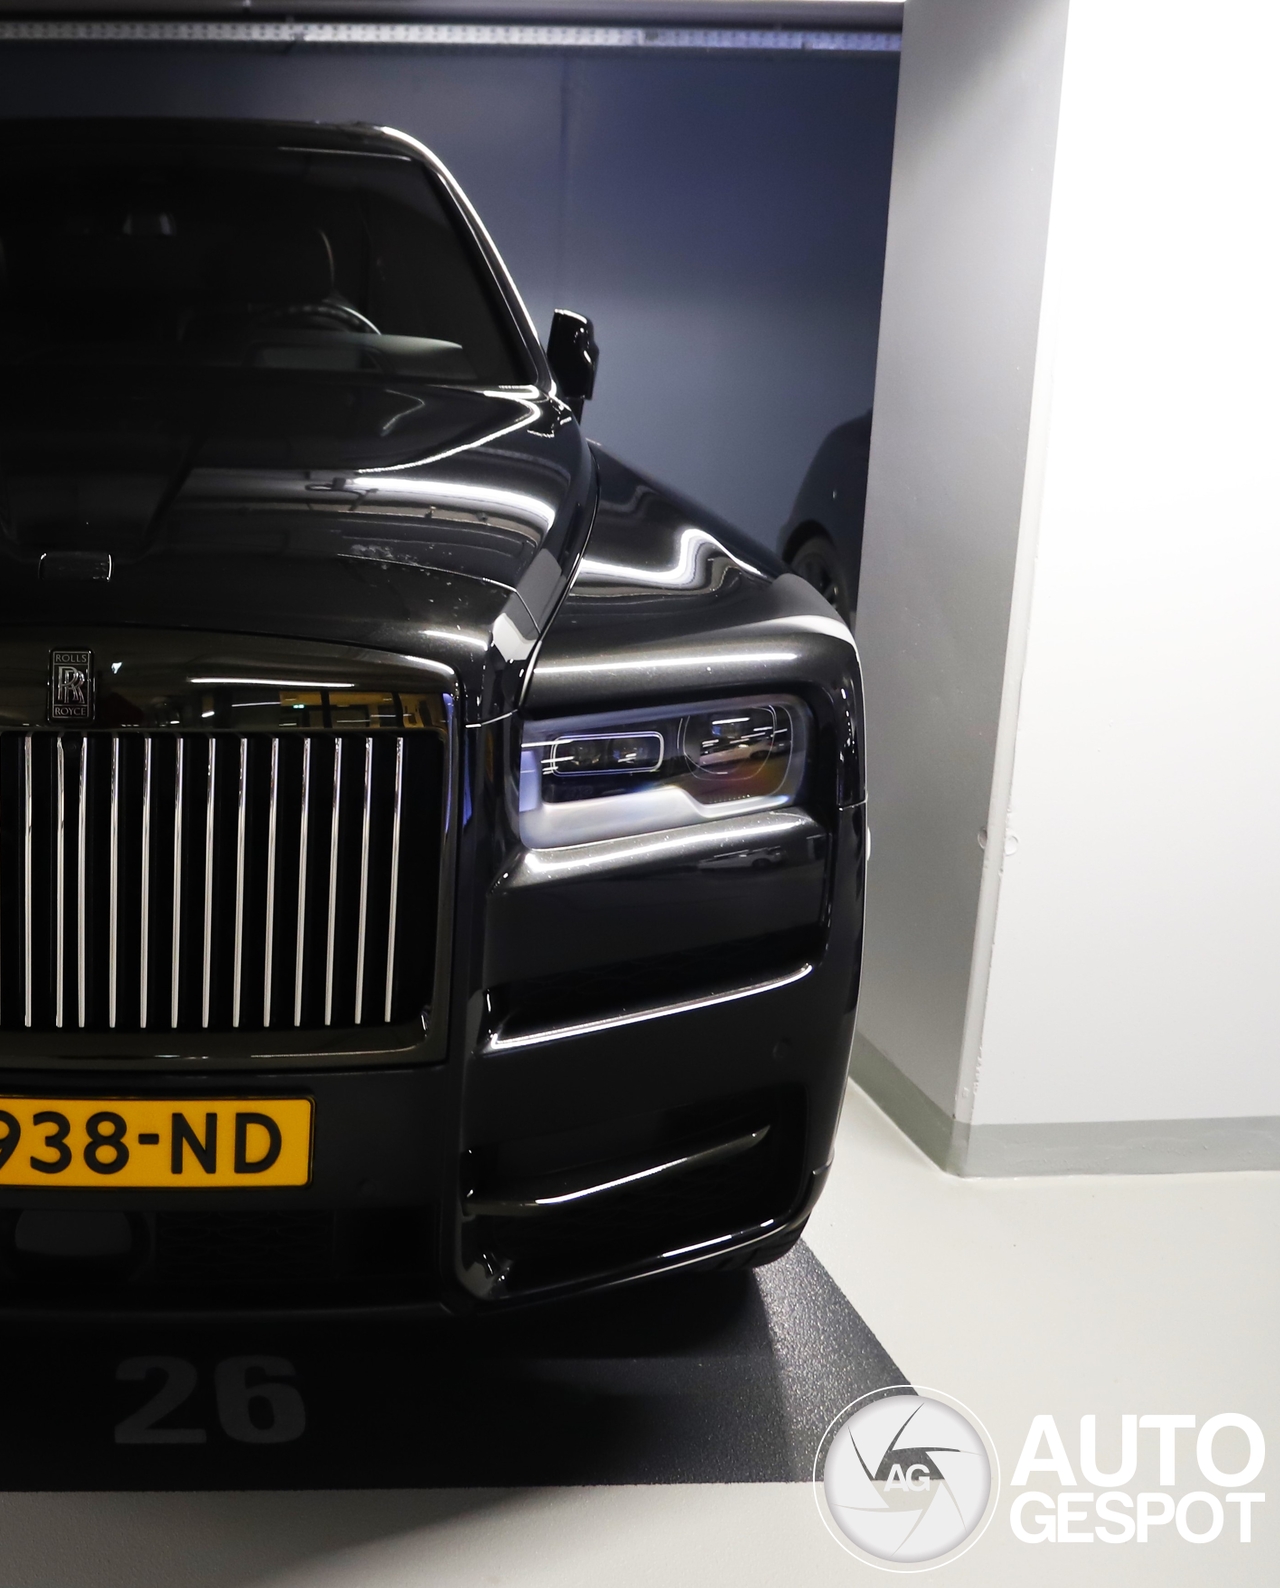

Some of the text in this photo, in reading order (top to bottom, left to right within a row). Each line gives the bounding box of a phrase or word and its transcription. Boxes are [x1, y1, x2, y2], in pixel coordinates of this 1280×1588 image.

[55, 654, 86, 662] ROLLS
[55, 707, 86, 715] ROYCE
[114, 1354, 307, 1444] 26
